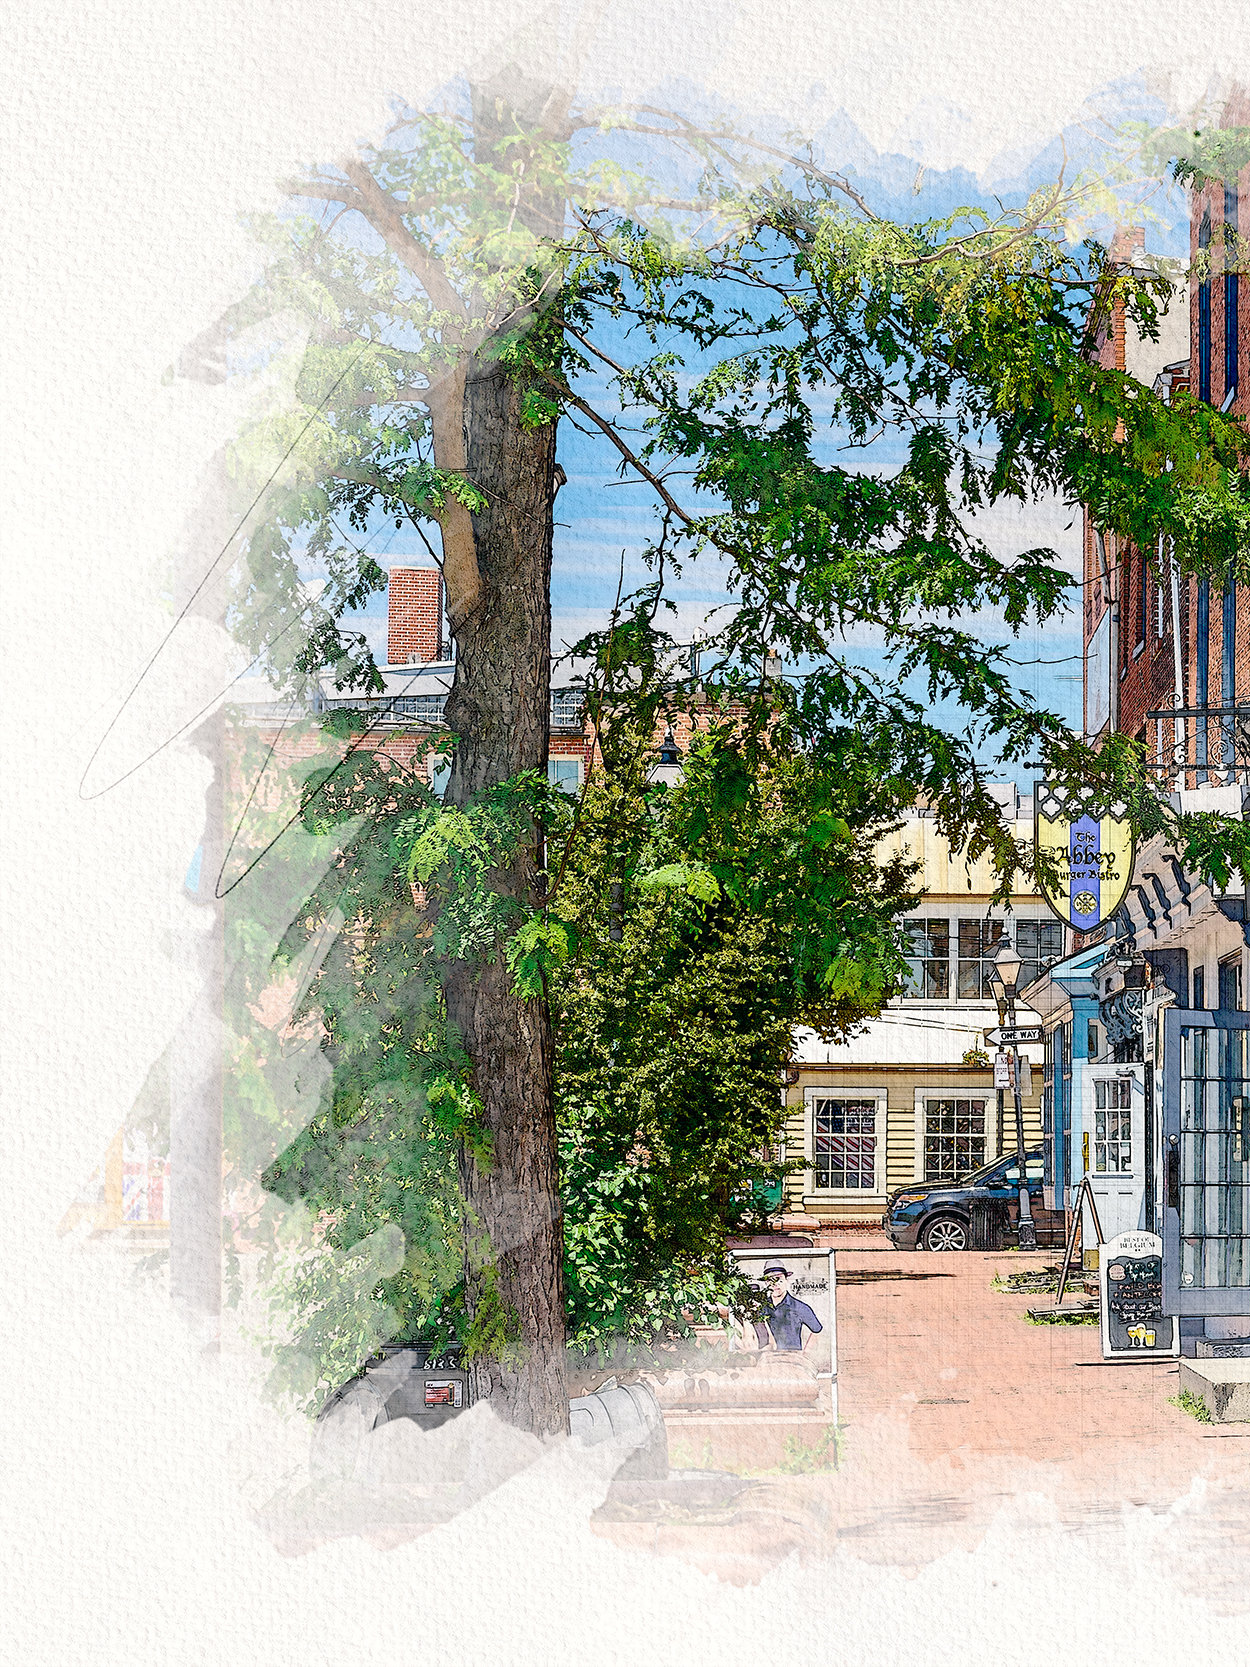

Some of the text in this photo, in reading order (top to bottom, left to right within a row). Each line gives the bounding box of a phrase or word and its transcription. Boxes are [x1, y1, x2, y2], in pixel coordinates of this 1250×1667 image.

[1075, 832, 1096, 842] The
[1056, 844, 1116, 870] Abbey
[1054, 869, 1121, 881] urger Bistro
[1001, 1030, 1037, 1040] ONE WAY
